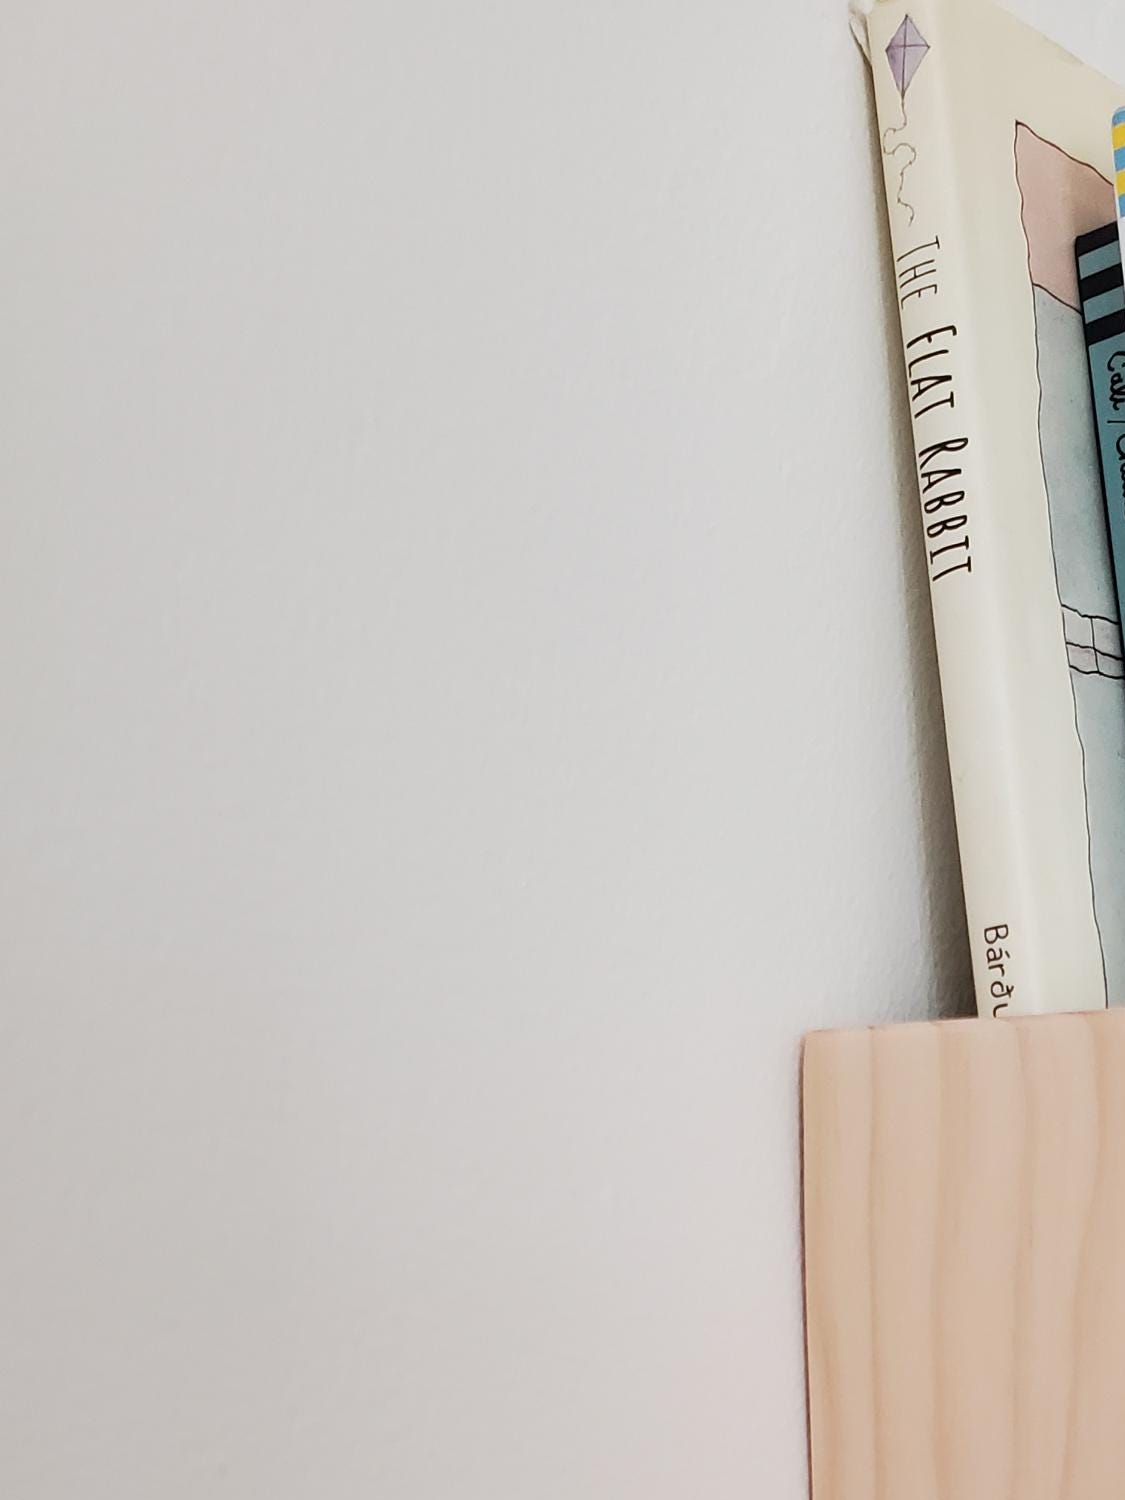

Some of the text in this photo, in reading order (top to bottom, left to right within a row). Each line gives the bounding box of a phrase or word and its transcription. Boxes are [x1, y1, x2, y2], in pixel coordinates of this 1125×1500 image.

[897, 236, 972, 582] THE FLAT RABBIT
